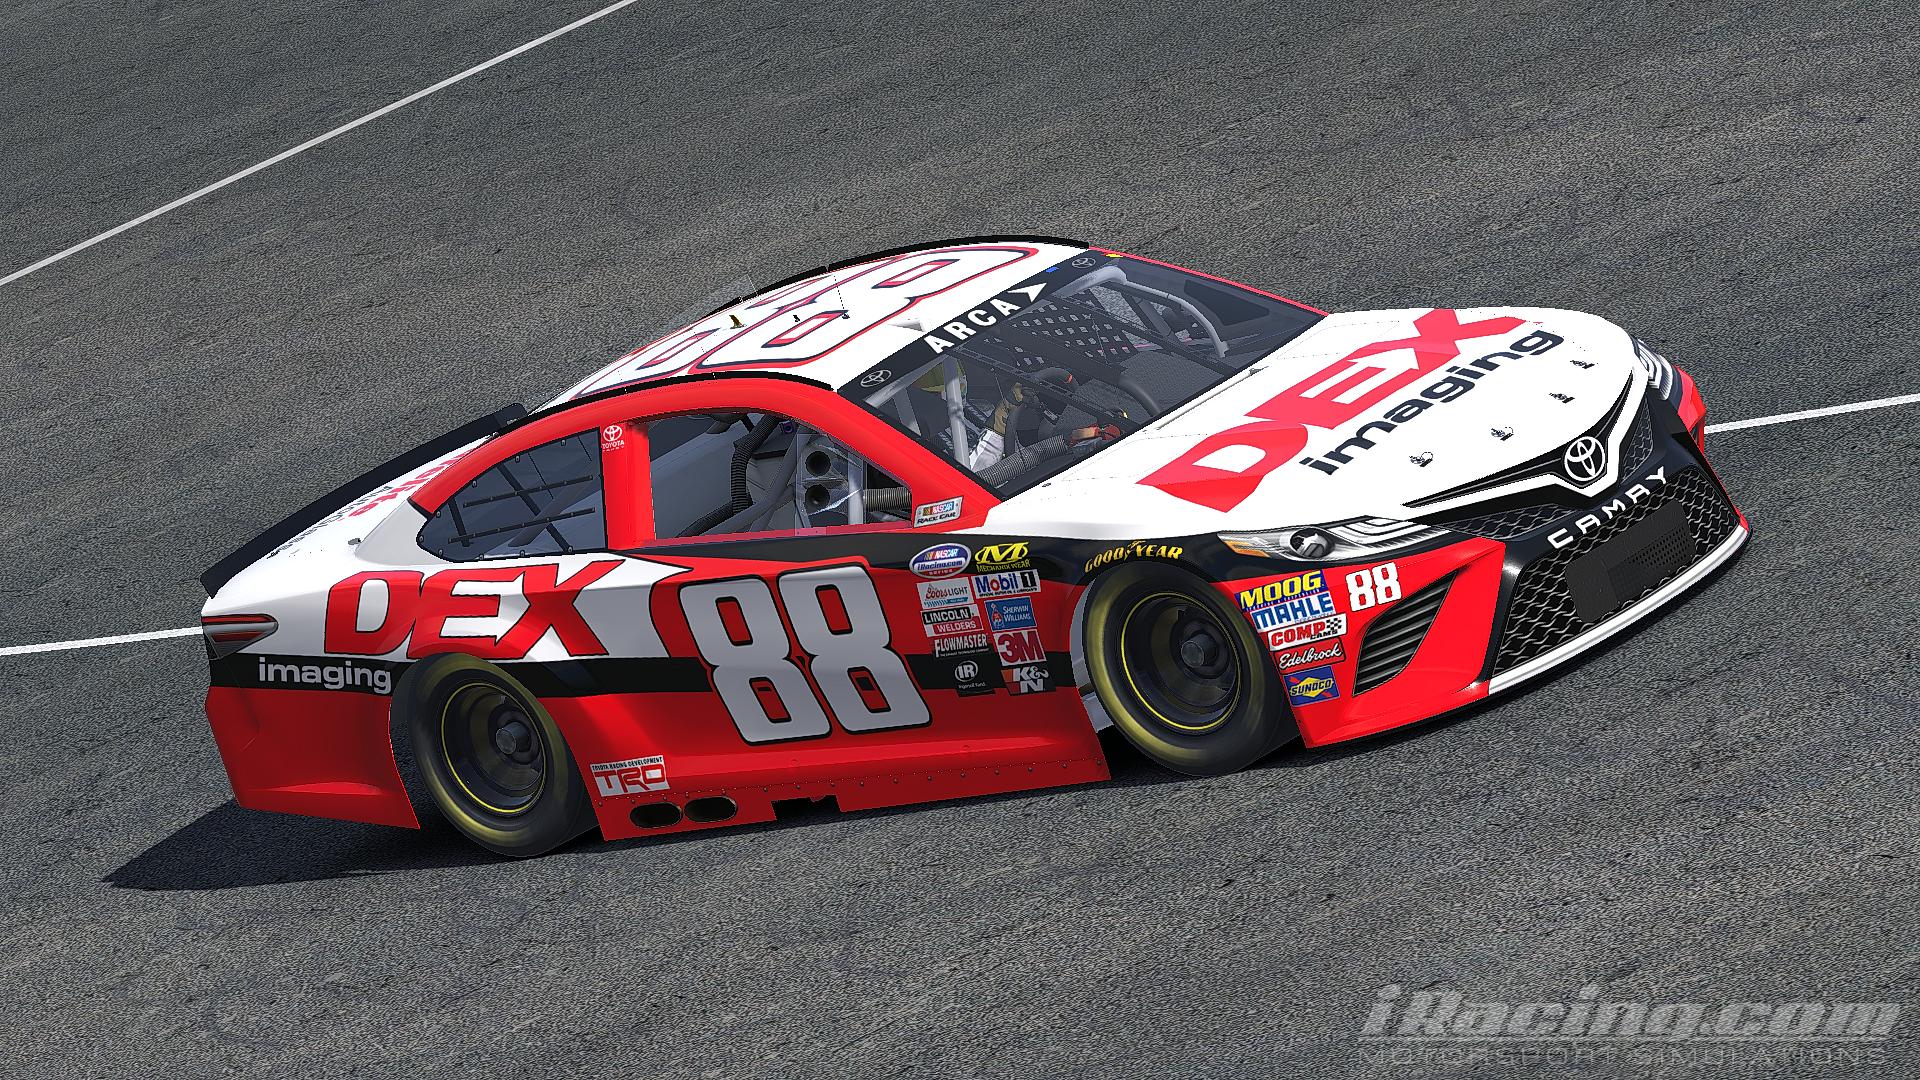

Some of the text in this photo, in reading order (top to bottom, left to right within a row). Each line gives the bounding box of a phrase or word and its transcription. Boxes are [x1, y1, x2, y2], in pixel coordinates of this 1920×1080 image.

[924, 298, 1022, 354] ARCA
[1135, 308, 1530, 514] DEX
[1299, 329, 1567, 476] imaging
[602, 440, 625, 450] TOYOTA
[931, 501, 955, 515] NASCAR
[1547, 465, 1667, 549] CAMRY
[917, 512, 956, 524] RACE CAR
[932, 549, 959, 560] NASCAR
[917, 560, 963, 571] iRacing.com
[976, 558, 1031, 573] MECHANIX WEAR
[926, 586, 968, 599] Coors LIGHT
[975, 573, 1019, 593] Mobil
[1240, 570, 1321, 609] MOOG
[1345, 562, 1402, 612] 88
[324, 559, 626, 659] DEX
[924, 608, 969, 623] LINCOLN
[1003, 605, 1028, 614] SHERWIN
[1003, 613, 1031, 622] WILLIAMS
[1252, 593, 1333, 629] MAHLE
[937, 621, 976, 632] WELDERS
[1271, 621, 1325, 646] COMP
[1310, 629, 1338, 640] CAMS
[678, 563, 932, 745] 88
[935, 634, 988, 658] FLOWMASTER
[998, 630, 1045, 663] 3M
[1279, 643, 1342, 670] Edelbrock
[259, 657, 392, 694] imaging
[1291, 679, 1332, 695] SUNOCO
[609, 762, 627, 770] RACING
[628, 756, 663, 767] DEVELOPMENT
